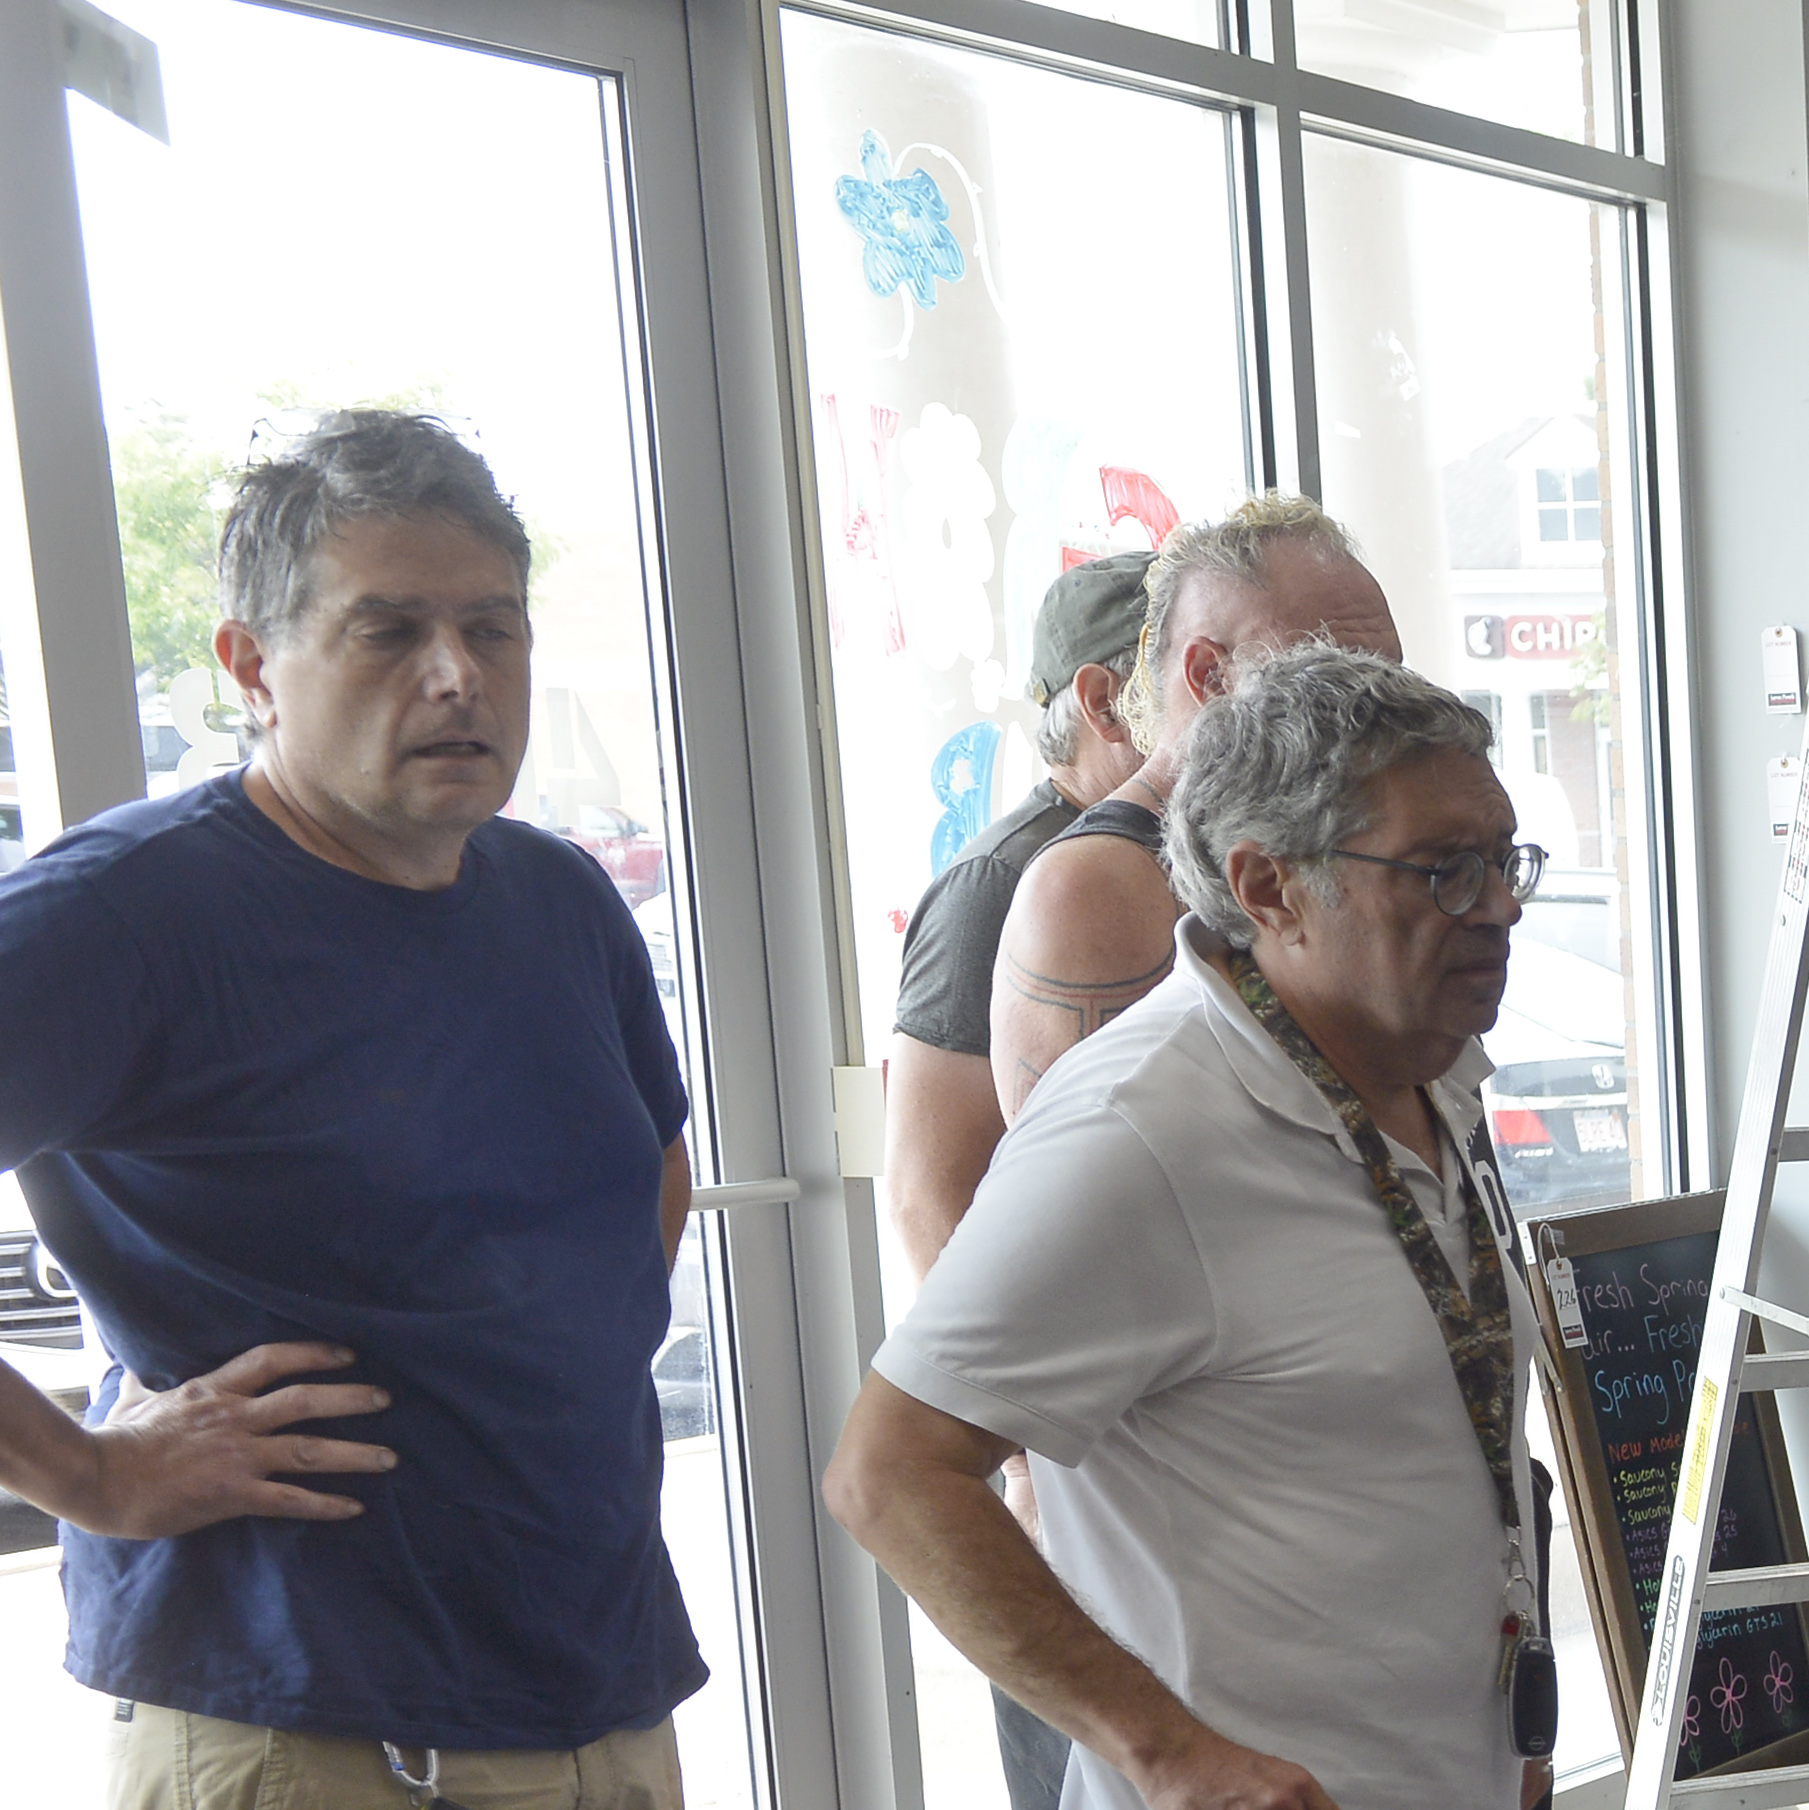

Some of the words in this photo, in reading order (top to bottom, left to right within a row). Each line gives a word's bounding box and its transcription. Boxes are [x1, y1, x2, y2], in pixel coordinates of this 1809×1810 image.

[1594, 1369, 1670, 1425] Spring
[1607, 1441, 1643, 1465] New
[1619, 1467, 1668, 1487] Saucony
[1623, 1484, 1668, 1504] Saucony
[1627, 1504, 1672, 1526] Saucony
[1654, 1555, 1686, 1701] LOUISVILLE
[1746, 1614, 1769, 1633] GTS
[1770, 1611, 1784, 1627] 21
